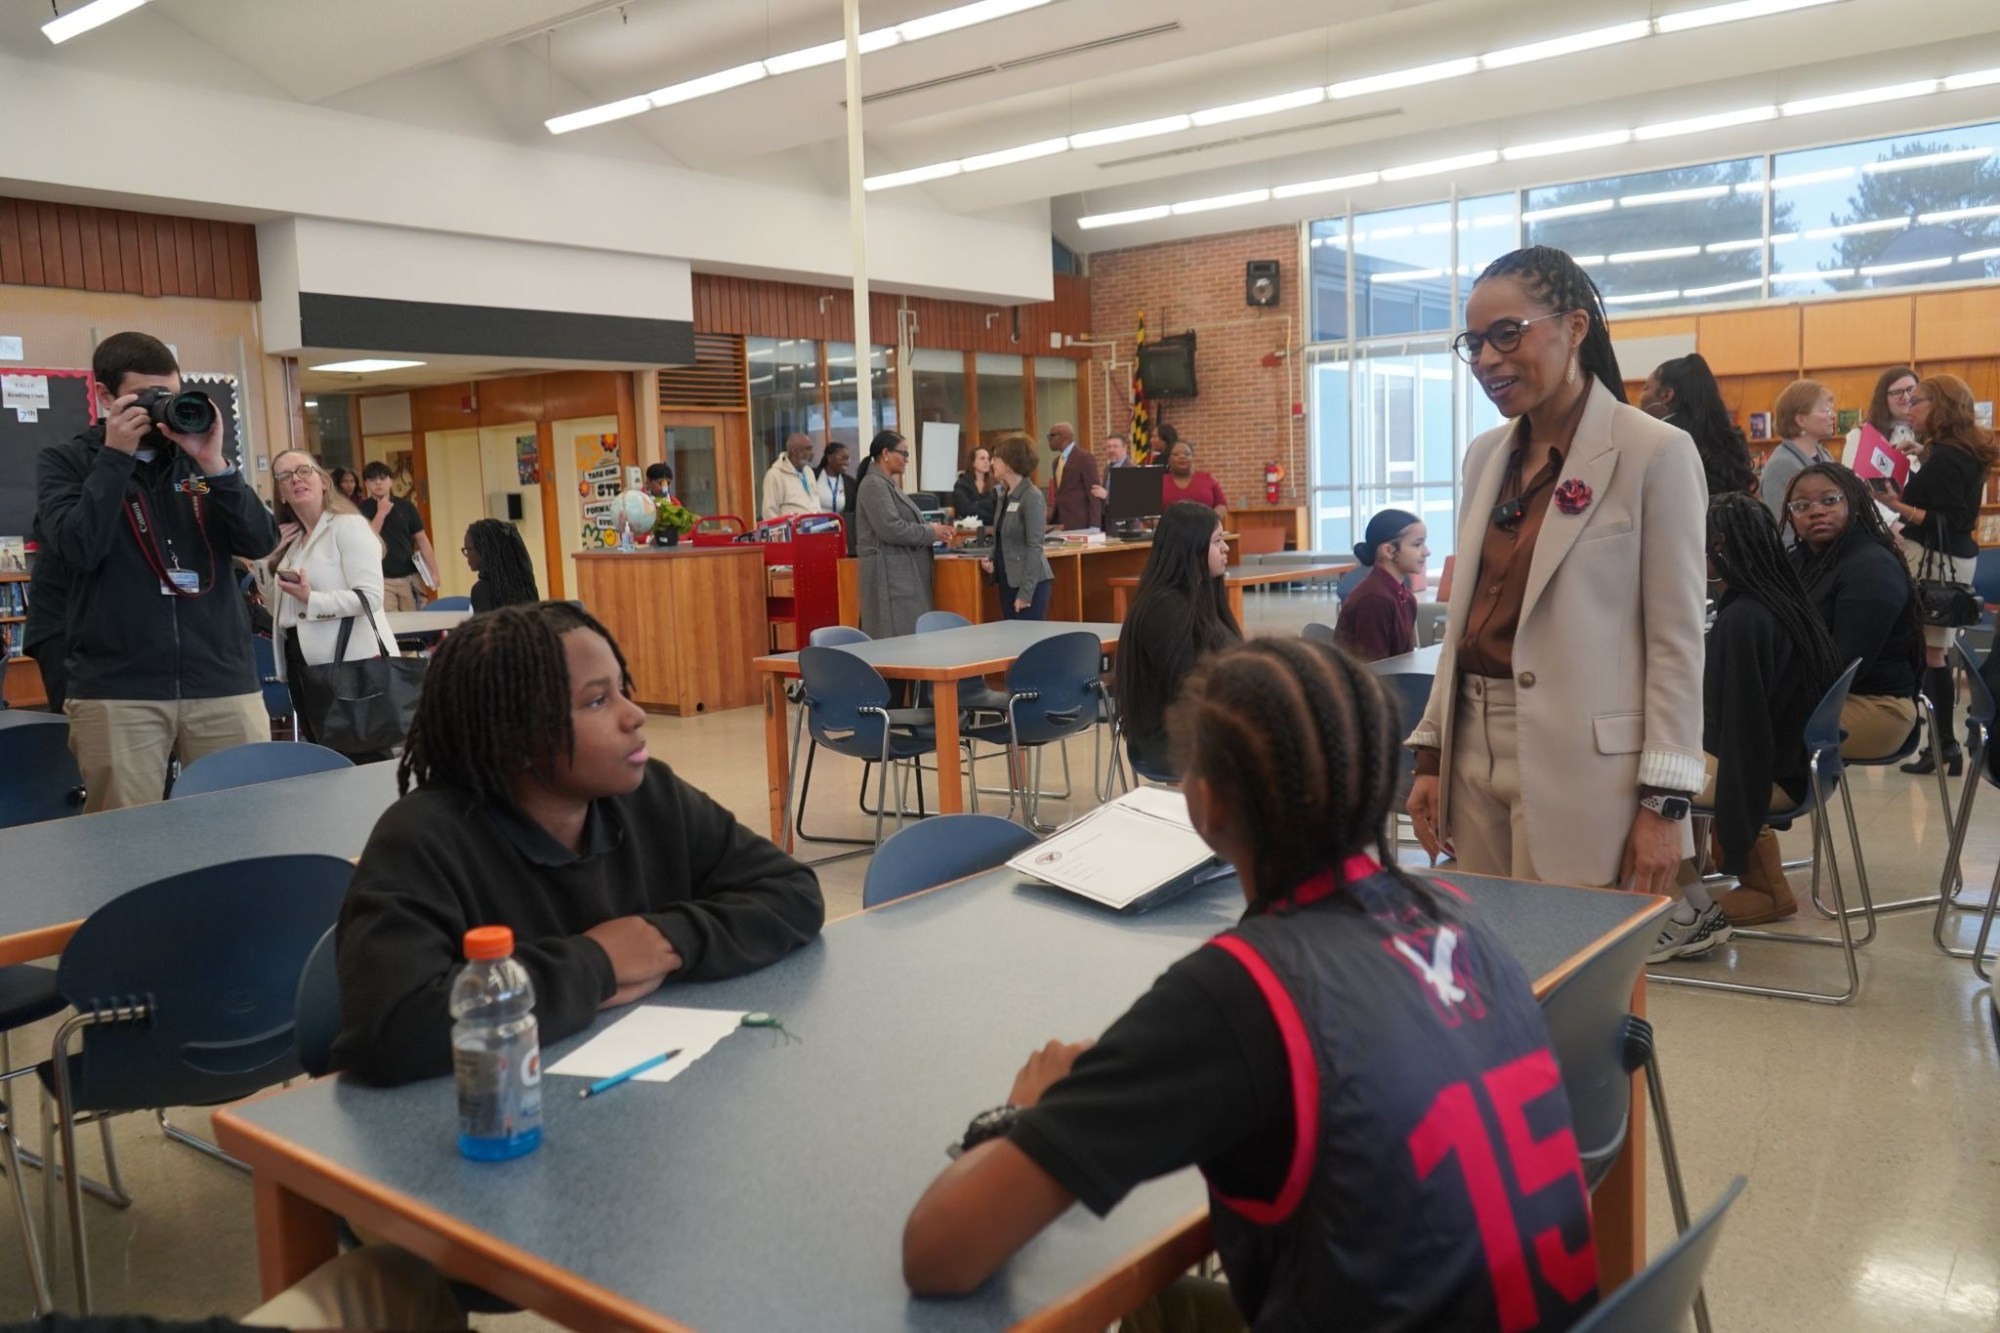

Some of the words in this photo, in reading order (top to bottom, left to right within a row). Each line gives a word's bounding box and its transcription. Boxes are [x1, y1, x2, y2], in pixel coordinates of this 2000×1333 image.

[588, 471, 603, 479] TAKE
[604, 467, 617, 476] ONE
[174, 481, 210, 493] BCS
[132, 502, 148, 533] Canon
[1408, 1047, 1598, 1333] 15
